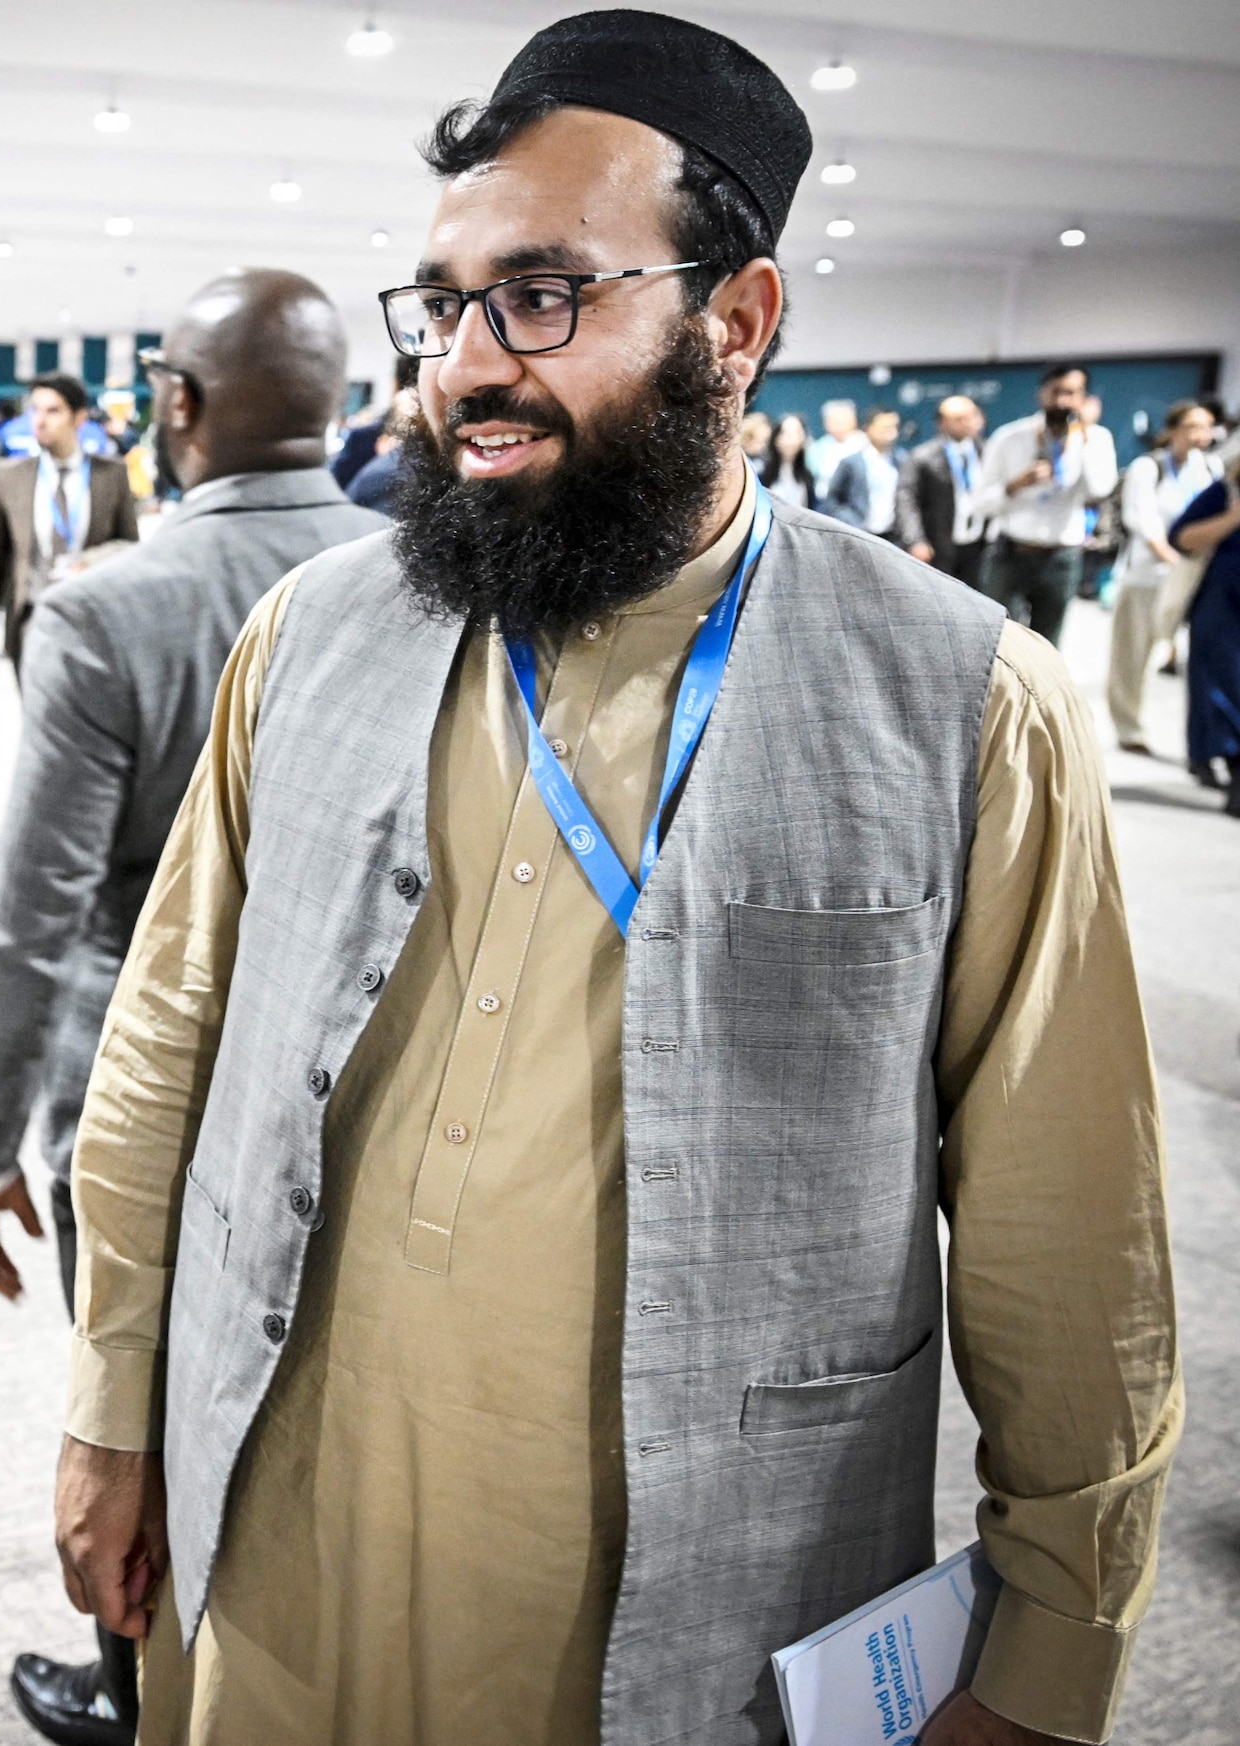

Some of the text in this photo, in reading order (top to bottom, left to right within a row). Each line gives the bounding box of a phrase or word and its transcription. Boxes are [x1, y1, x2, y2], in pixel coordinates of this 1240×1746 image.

[865, 1631, 897, 1740] World Health
[883, 1622, 913, 1731] Organization
